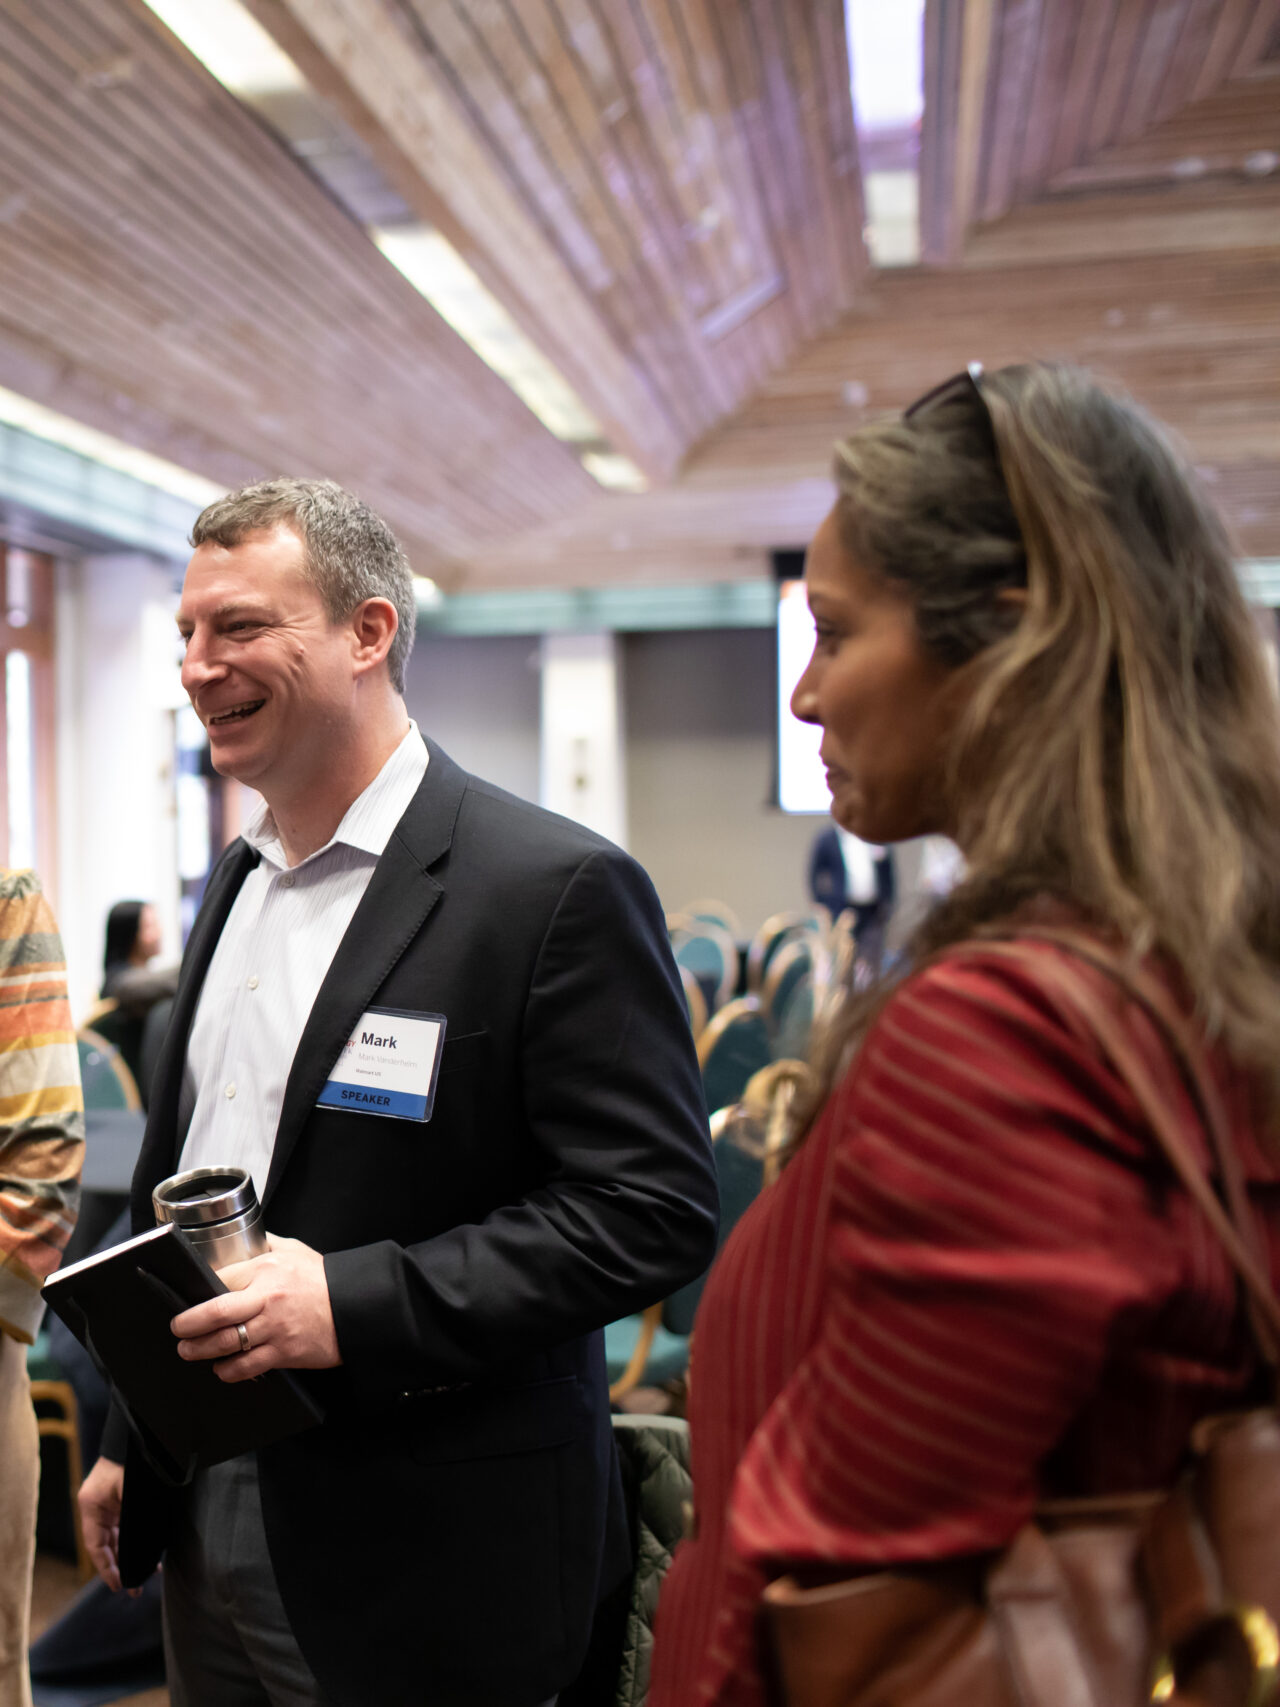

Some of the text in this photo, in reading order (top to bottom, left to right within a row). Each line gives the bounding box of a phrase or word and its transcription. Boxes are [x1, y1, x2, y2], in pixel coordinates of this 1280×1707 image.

[361, 1032, 397, 1049] Mark
[359, 1052, 375, 1061] Mark
[341, 1090, 391, 1106] SPEAKER
